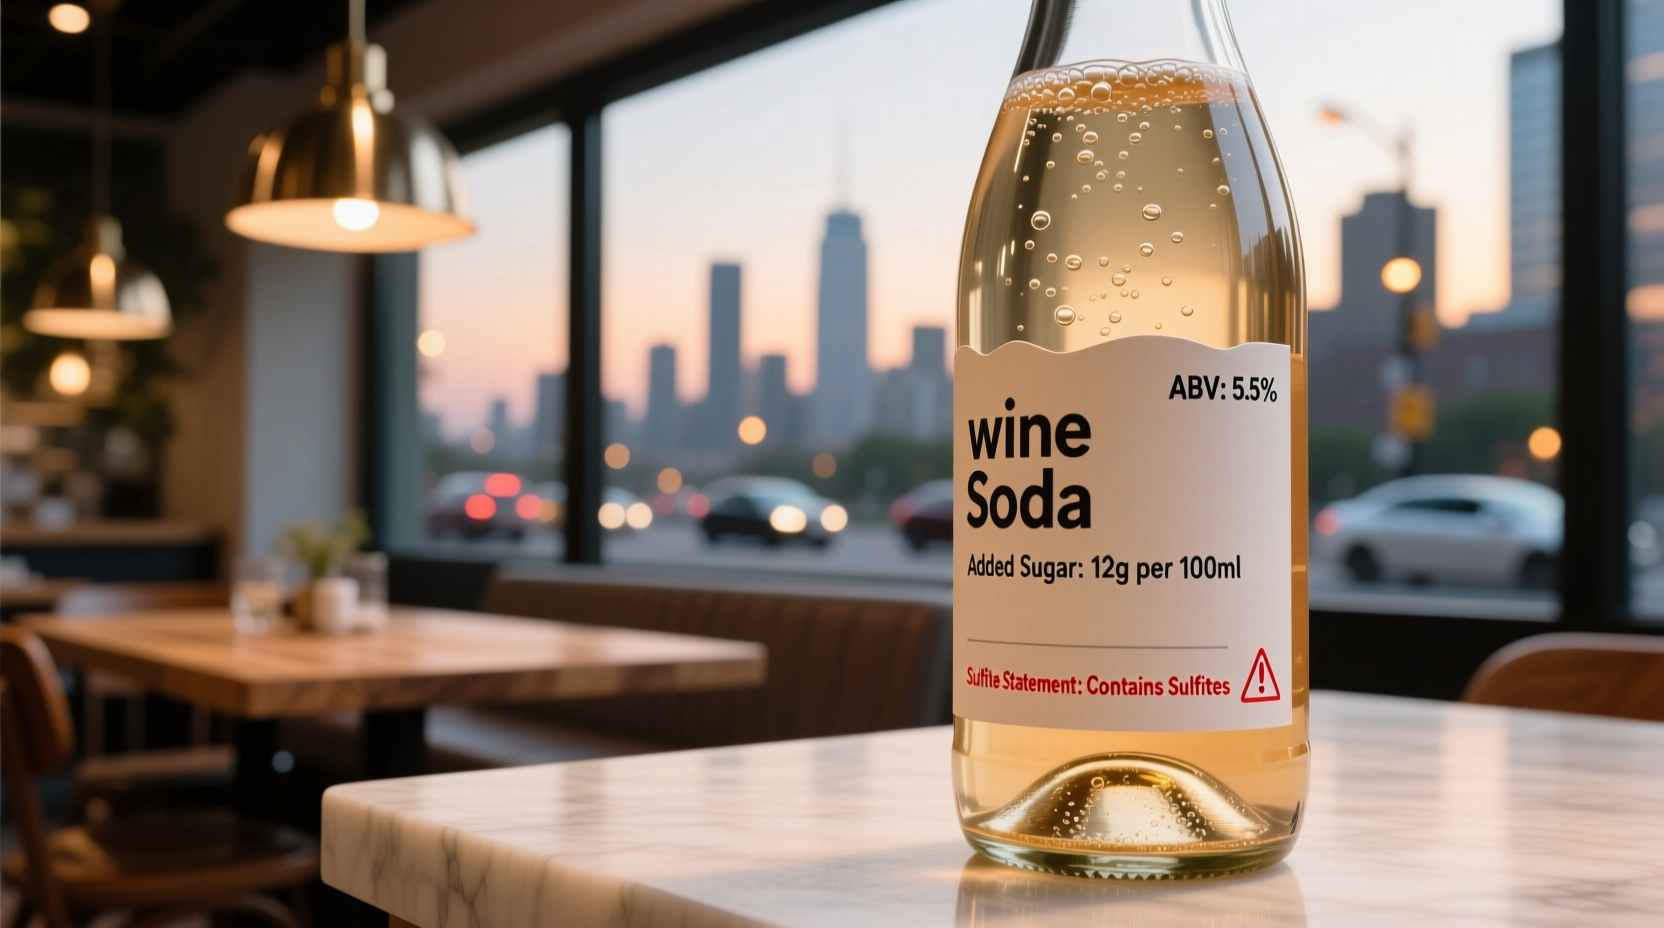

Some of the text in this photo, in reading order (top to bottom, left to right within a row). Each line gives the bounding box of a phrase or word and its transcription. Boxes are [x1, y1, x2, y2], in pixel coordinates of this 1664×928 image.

[1168, 374, 1278, 402] ABV: 5.5%
[967, 397, 1092, 460] wine
[966, 467, 1092, 529] Soda
[967, 553, 1241, 585] Added Sugar: 12g per 100ml
[1002, 670, 1083, 695] Statement:
[1086, 674, 1164, 696] Contains
[1168, 675, 1231, 696] Sulfites
